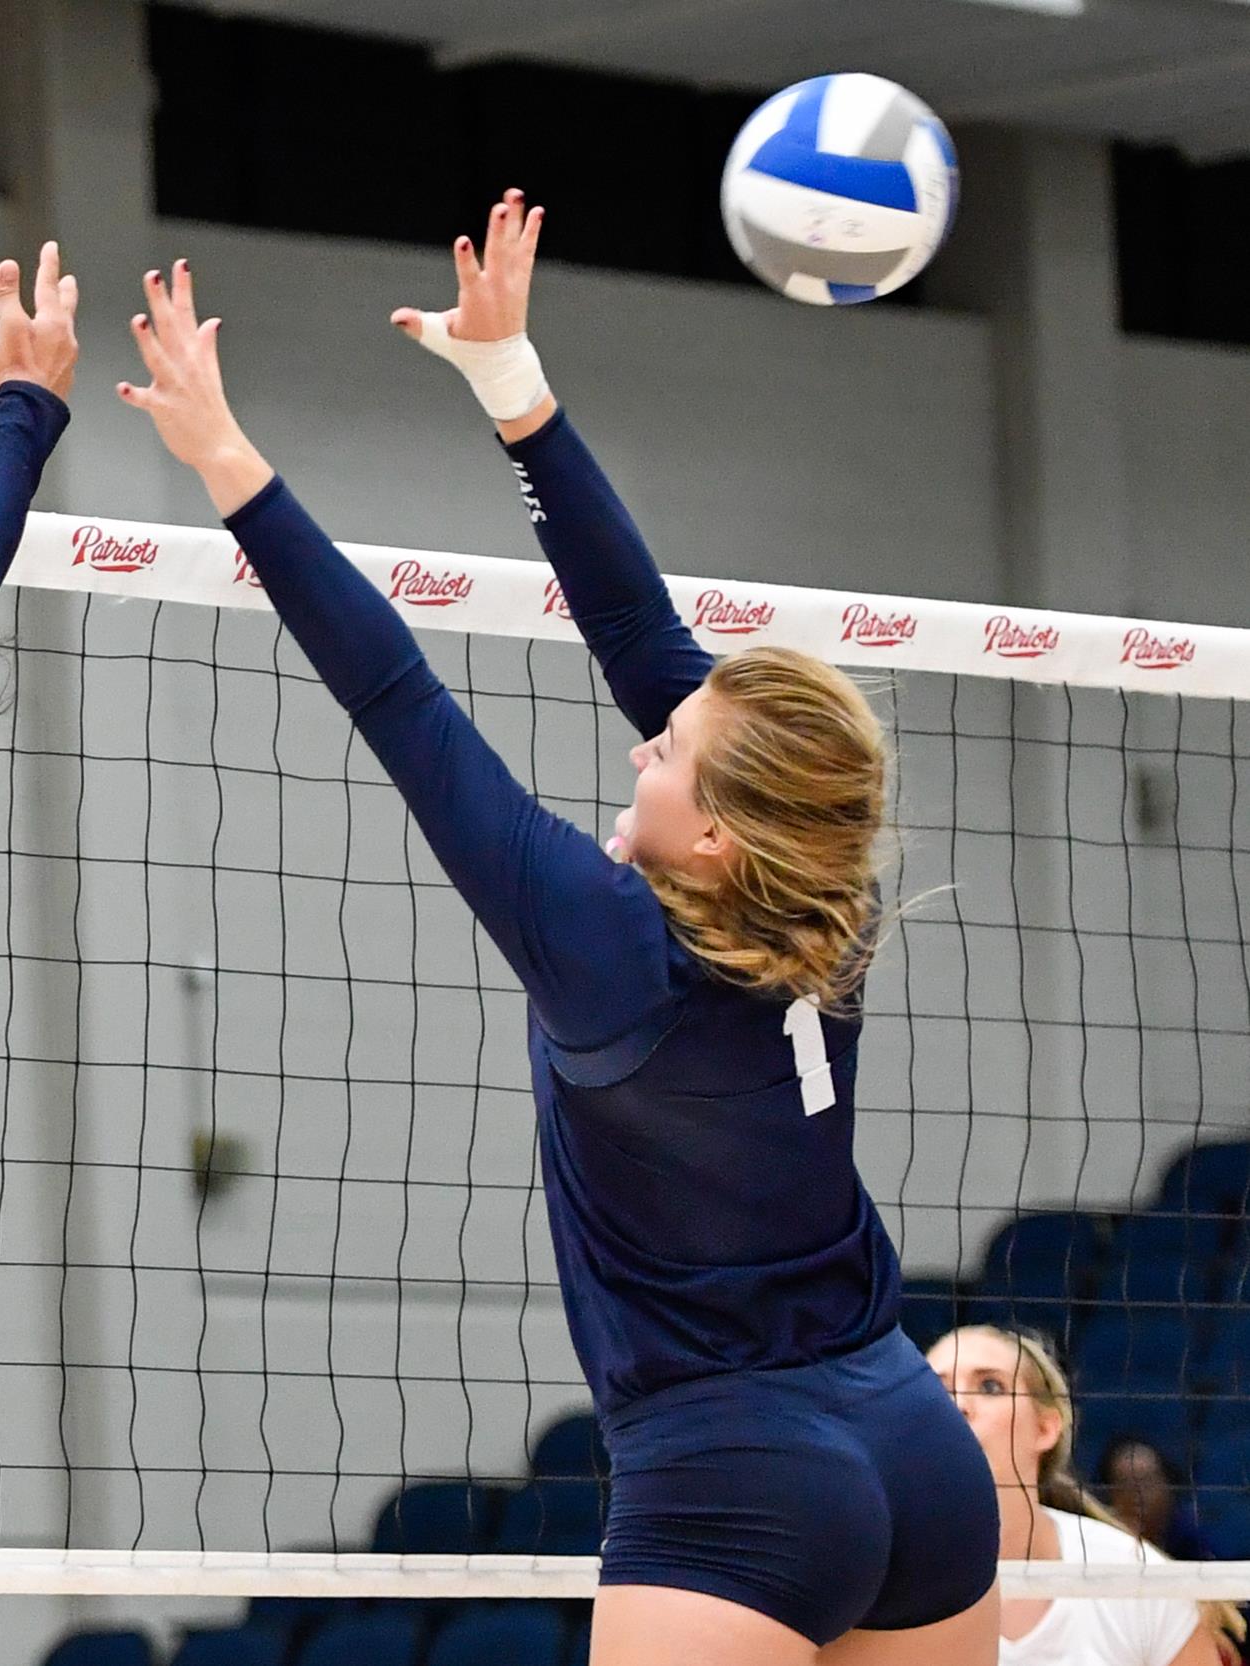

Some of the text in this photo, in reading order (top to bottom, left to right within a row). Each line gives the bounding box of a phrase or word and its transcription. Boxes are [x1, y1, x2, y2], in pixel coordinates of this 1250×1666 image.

[72, 526, 158, 571] Patriots
[390, 560, 474, 605] Patriots
[695, 589, 775, 633] Patriots
[841, 603, 918, 645] Patriots
[984, 616, 1060, 656] Patriots
[1120, 627, 1194, 667] Patriots
[783, 993, 836, 1116] 1
